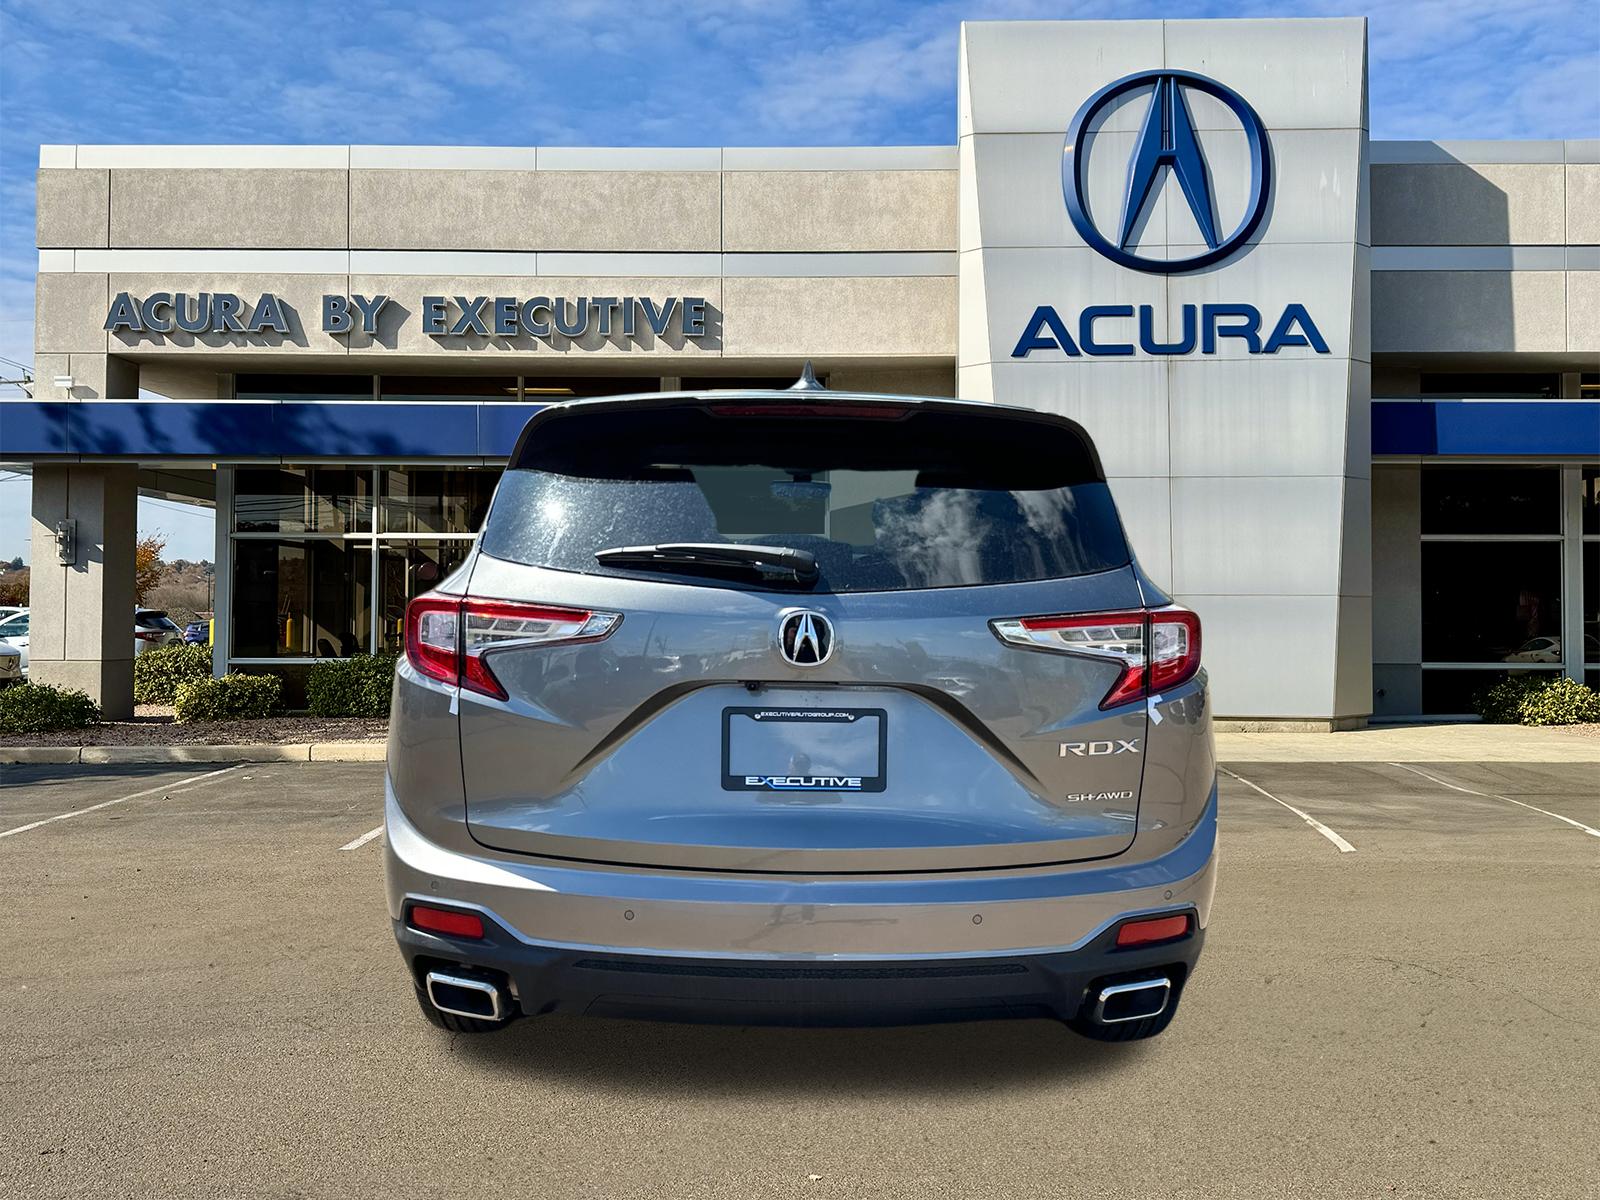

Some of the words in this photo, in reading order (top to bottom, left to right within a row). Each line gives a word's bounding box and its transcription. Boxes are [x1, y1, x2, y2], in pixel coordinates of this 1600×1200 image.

[104, 291, 290, 334] ACURA
[322, 293, 390, 335] BY
[422, 295, 707, 337] EXECUTIVE
[1011, 303, 1331, 357] ACURA
[760, 711, 850, 719] EXECUTIVEAUTOGROUP.COM
[1058, 738, 1141, 758] RDX
[745, 776, 862, 787] EXECUTIVE
